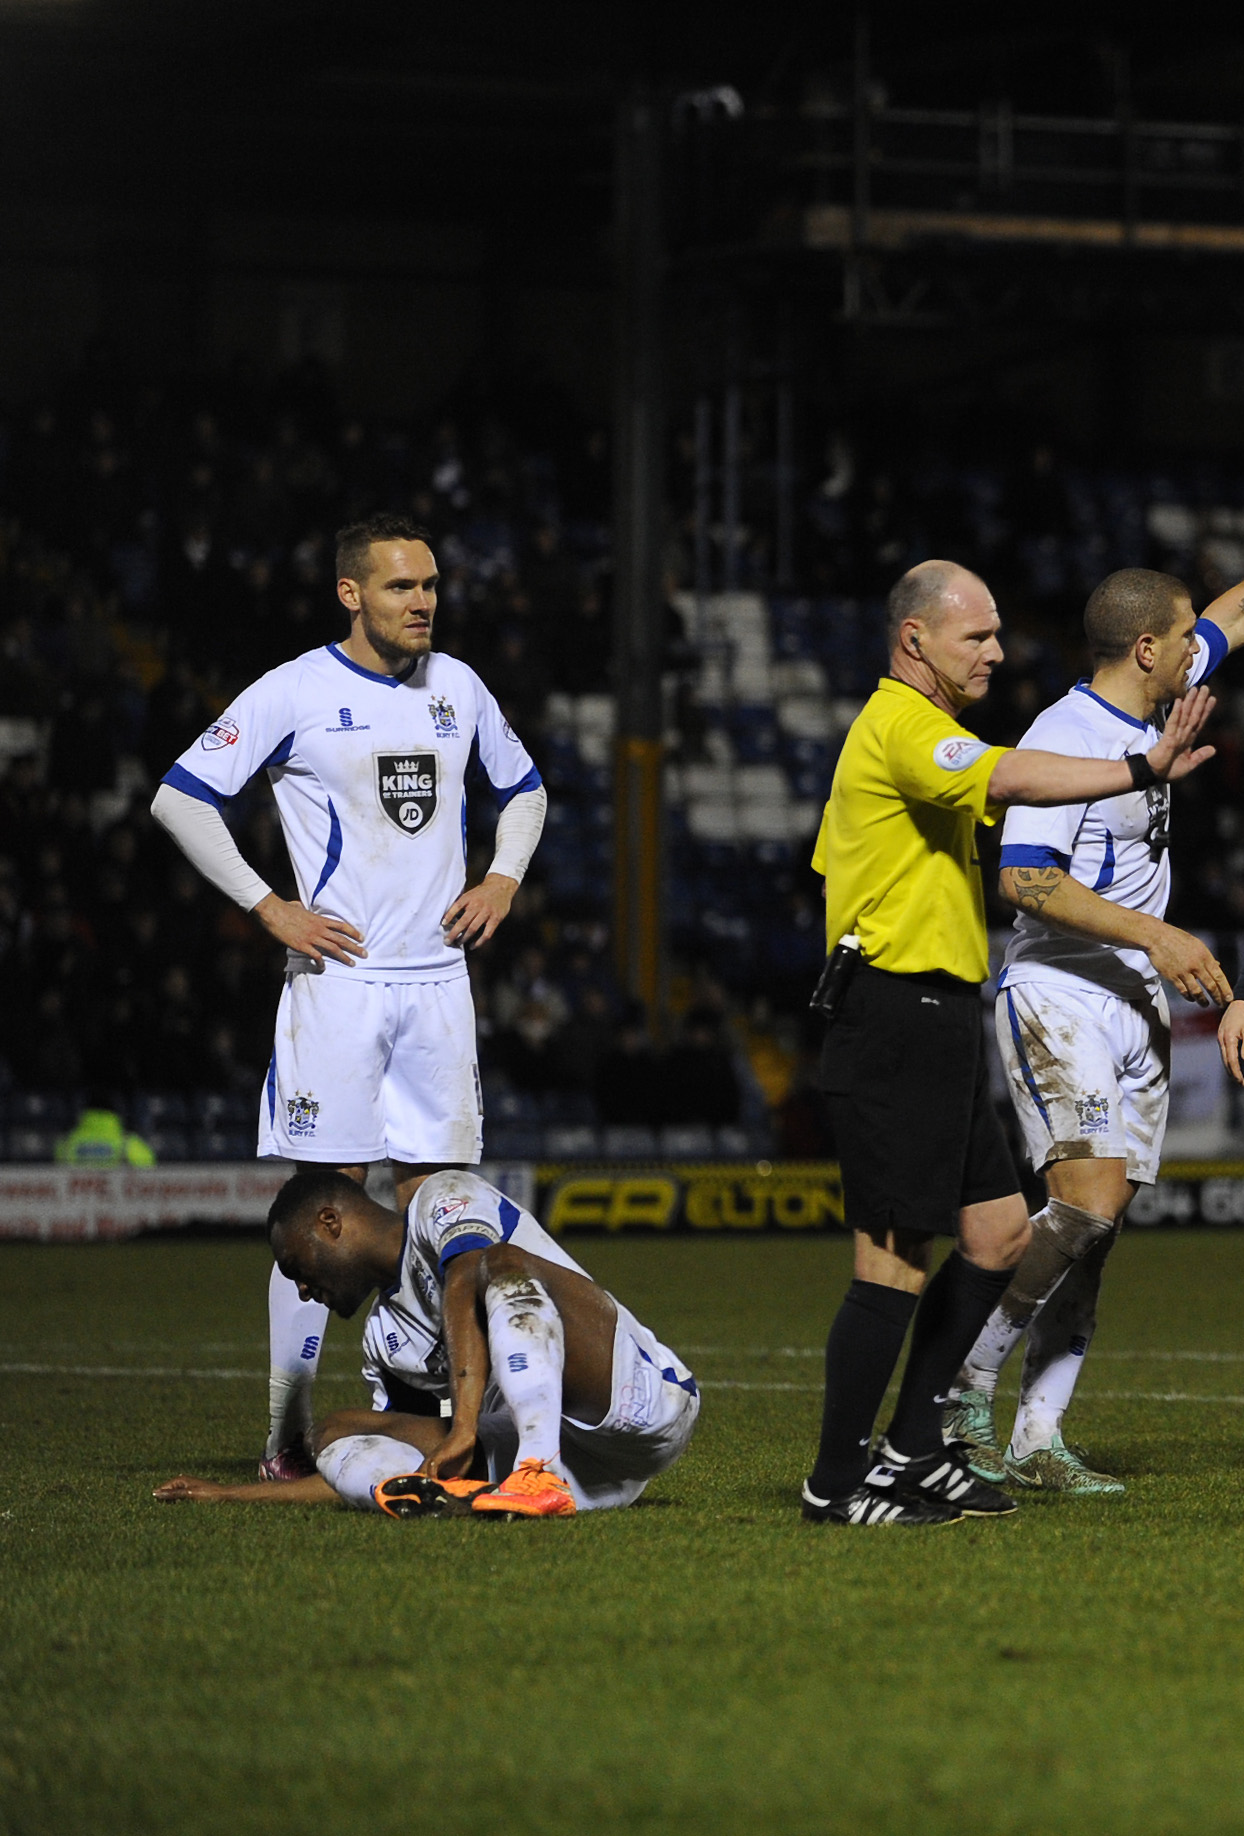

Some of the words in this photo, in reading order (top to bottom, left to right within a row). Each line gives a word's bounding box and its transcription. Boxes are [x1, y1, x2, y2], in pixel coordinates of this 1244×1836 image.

[382, 774, 433, 791] KING
[392, 790, 433, 799] TRAINERS
[402, 808, 419, 821] JD
